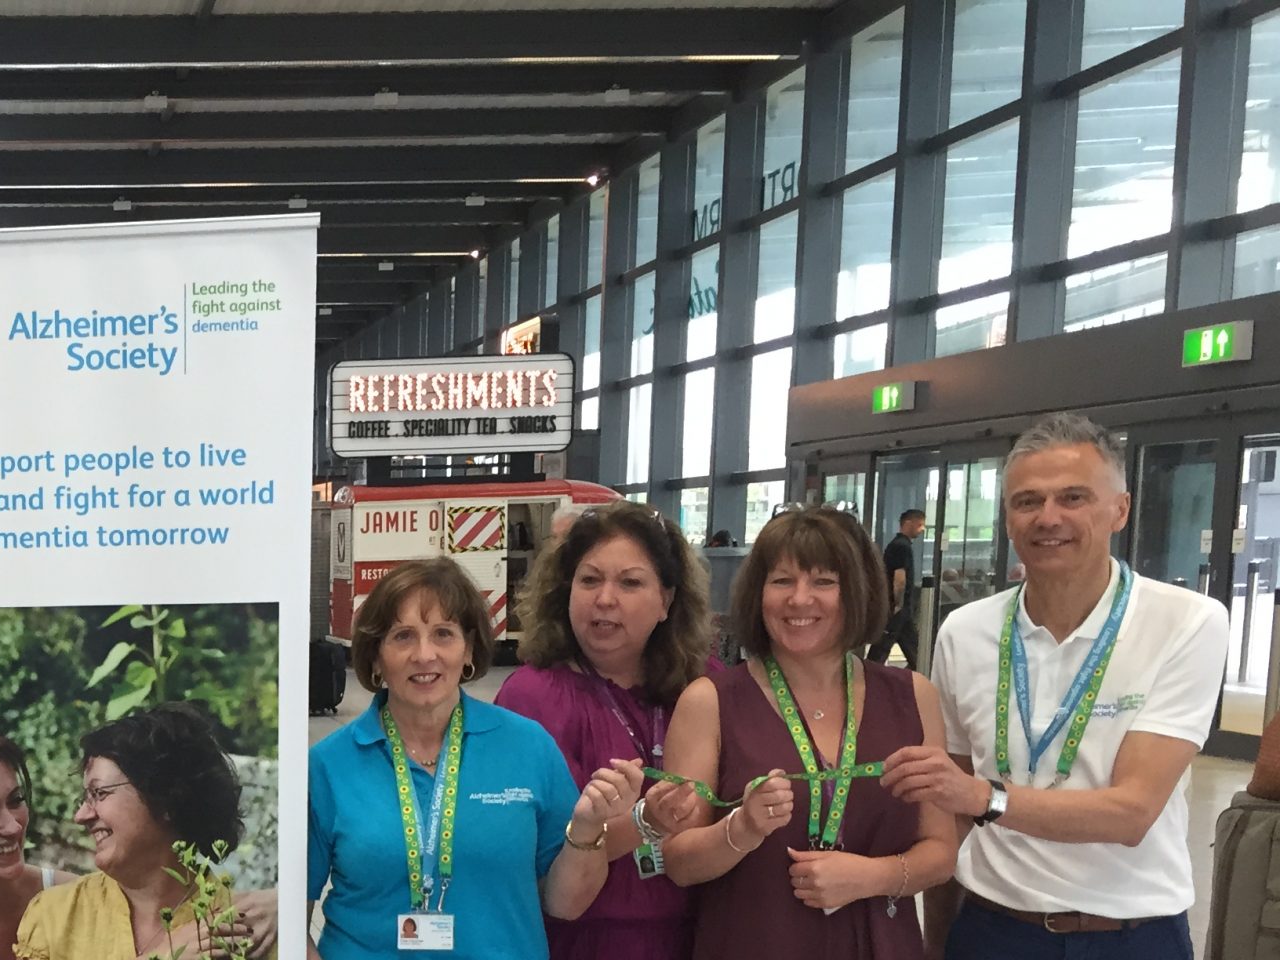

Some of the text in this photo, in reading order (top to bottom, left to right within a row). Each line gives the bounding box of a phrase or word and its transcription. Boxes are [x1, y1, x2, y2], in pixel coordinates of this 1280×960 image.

[192, 279, 276, 298] Leading the
[192, 298, 281, 316] fight against
[9, 305, 178, 340] Alzheimer's
[192, 318, 258, 333] dementia
[67, 342, 177, 375] Society
[350, 369, 558, 413] REFRESHMENTS
[348, 415, 557, 438] COFFEE SPECIALITY TEA SNACKS
[64, 445, 154, 477] people
[163, 447, 191, 469] to
[199, 443, 247, 466] live
[55, 485, 119, 515] fight
[128, 484, 165, 507] for
[174, 488, 190, 507] a
[199, 481, 275, 506] world
[360, 510, 418, 534] JAMIE
[97, 523, 229, 547] tomorrow
